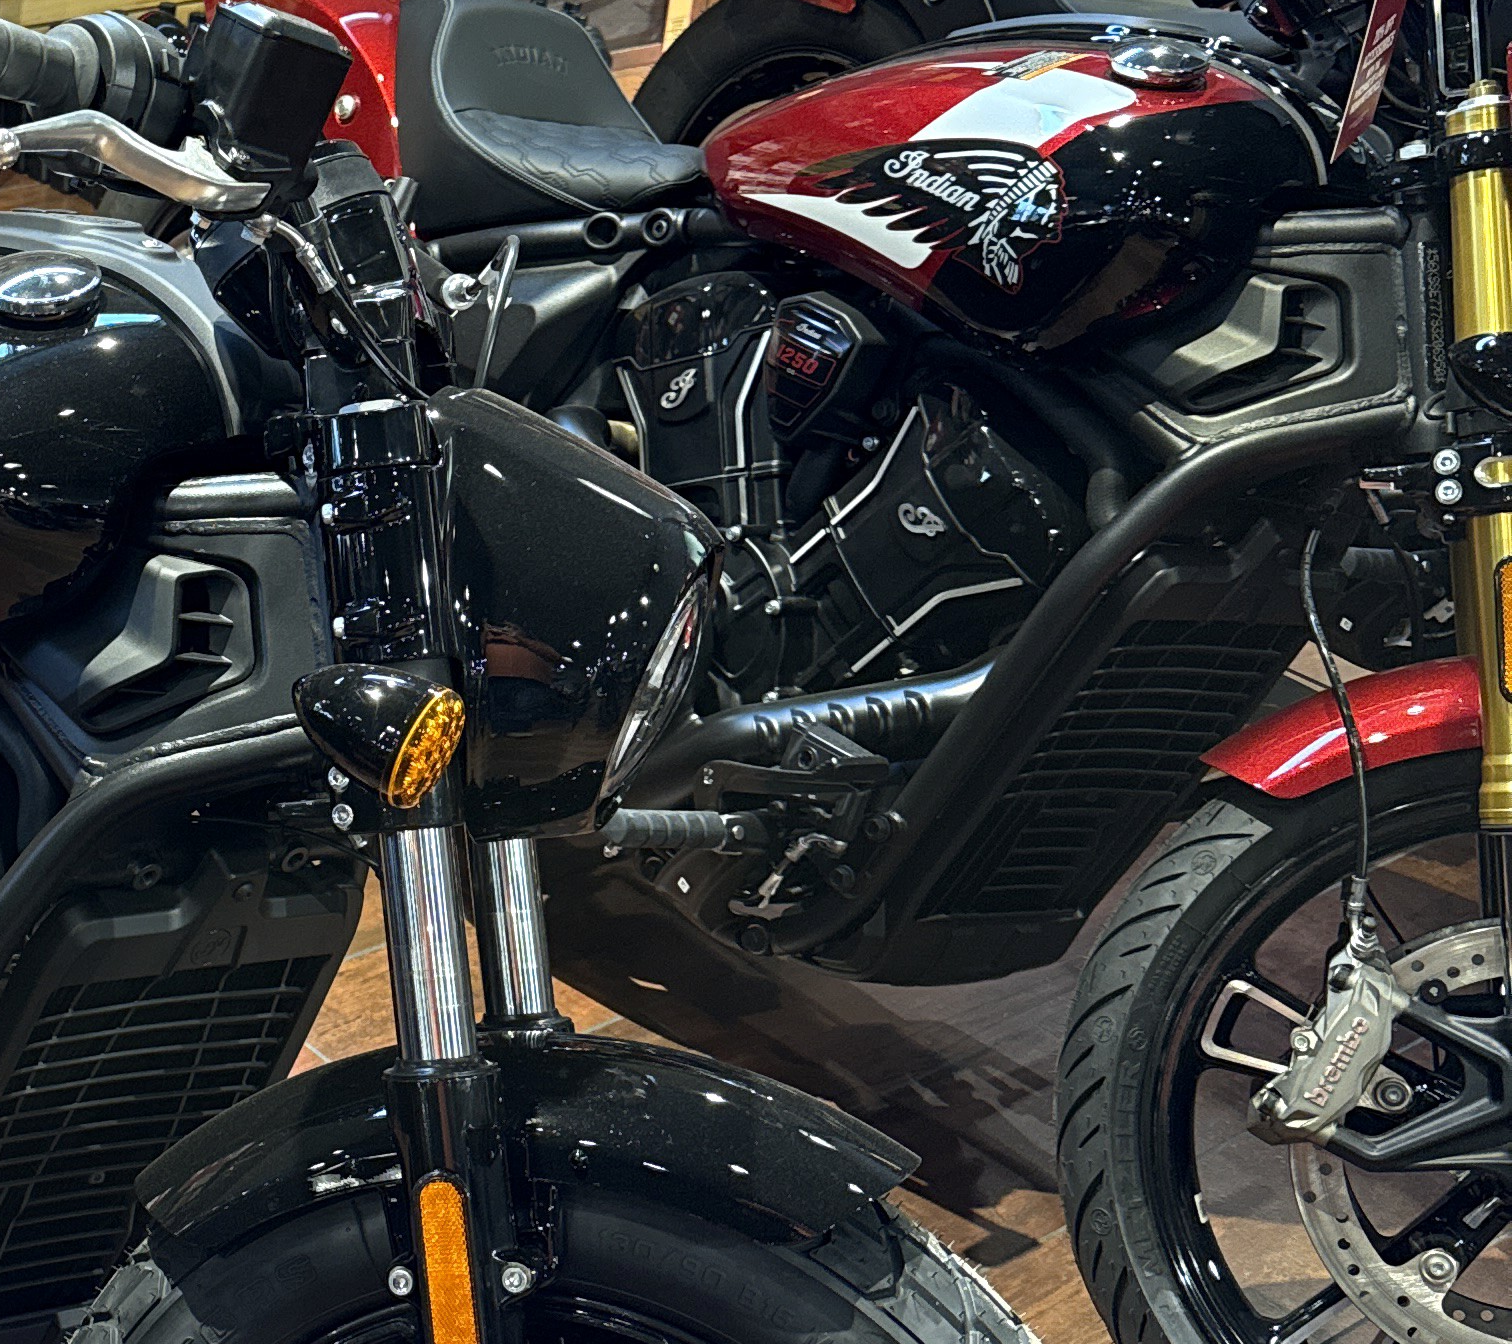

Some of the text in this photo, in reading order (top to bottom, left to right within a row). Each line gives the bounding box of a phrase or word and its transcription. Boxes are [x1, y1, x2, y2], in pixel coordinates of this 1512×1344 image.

[884, 150, 979, 213] Indian
[796, 323, 822, 339] Indian
[776, 343, 818, 376] 1250
[1311, 1016, 1369, 1108] brembo
